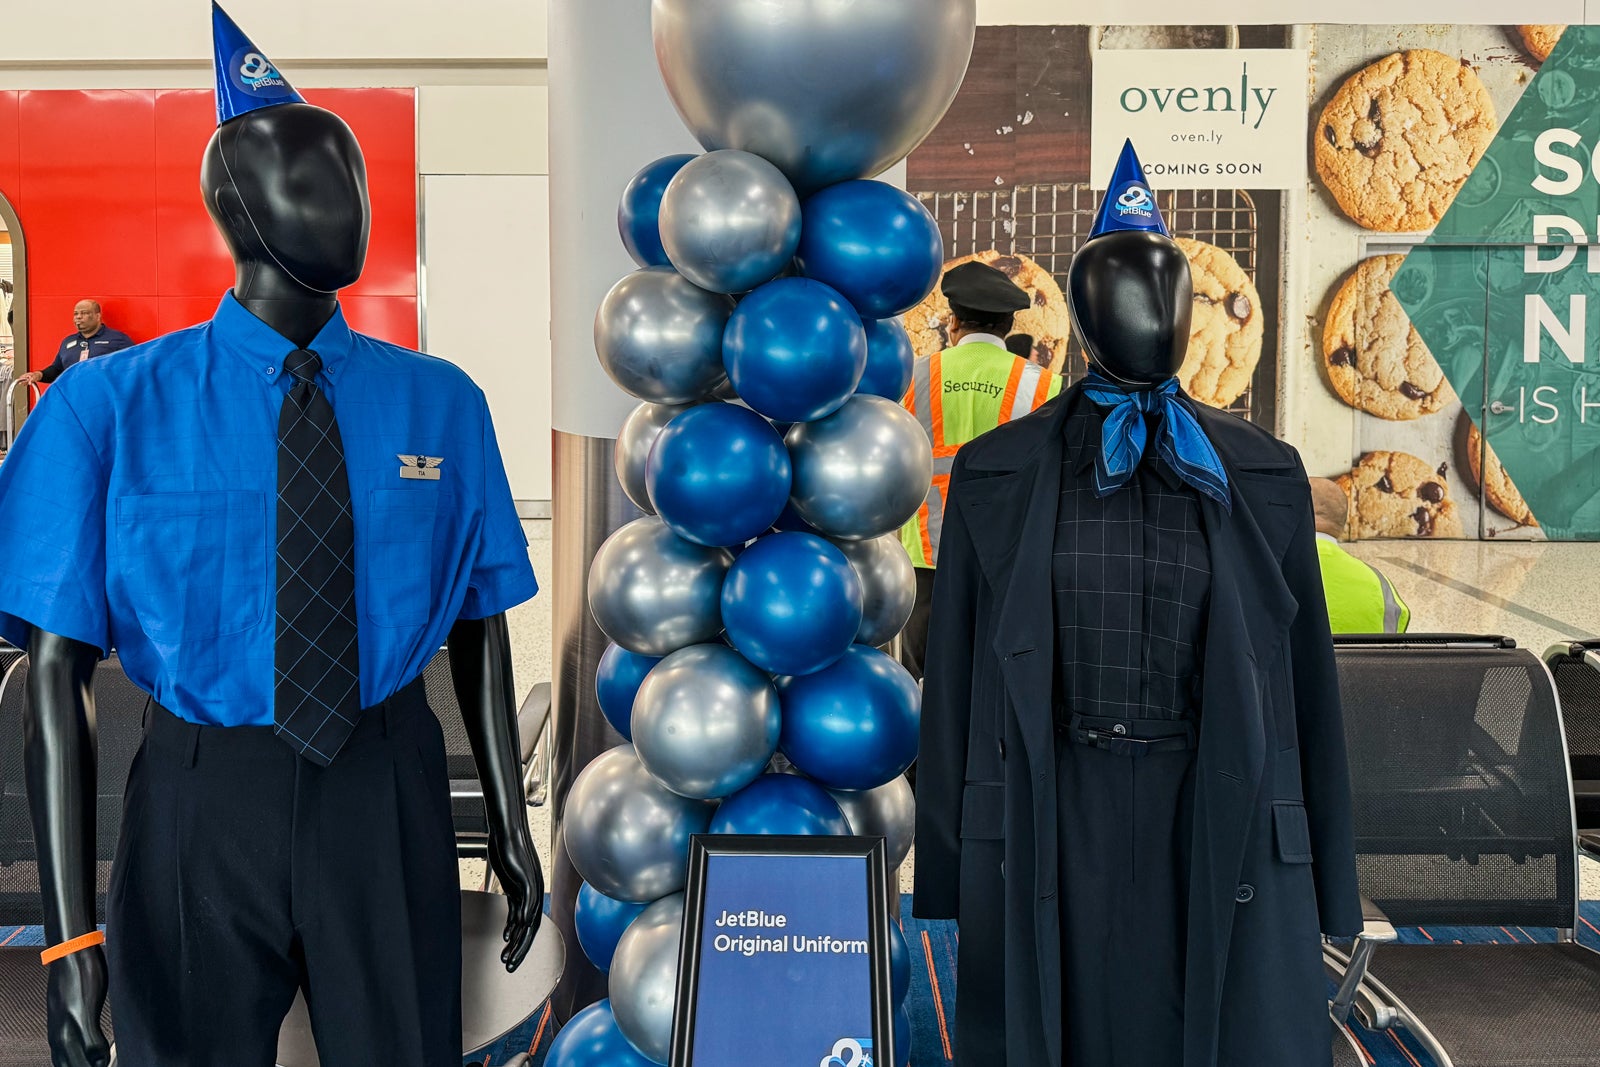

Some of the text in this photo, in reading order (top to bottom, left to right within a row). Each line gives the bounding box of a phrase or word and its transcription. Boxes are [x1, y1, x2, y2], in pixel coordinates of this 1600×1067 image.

[1120, 61, 1278, 129] ovenly
[1171, 130, 1223, 144] oven.ly
[1142, 163, 1262, 175] COMING SOON
[1531, 128, 1600, 196] S
[943, 380, 1004, 399] Security
[1519, 385, 1559, 424] IS
[715, 910, 787, 928] JetBlue
[713, 934, 869, 957] Original Uniform
